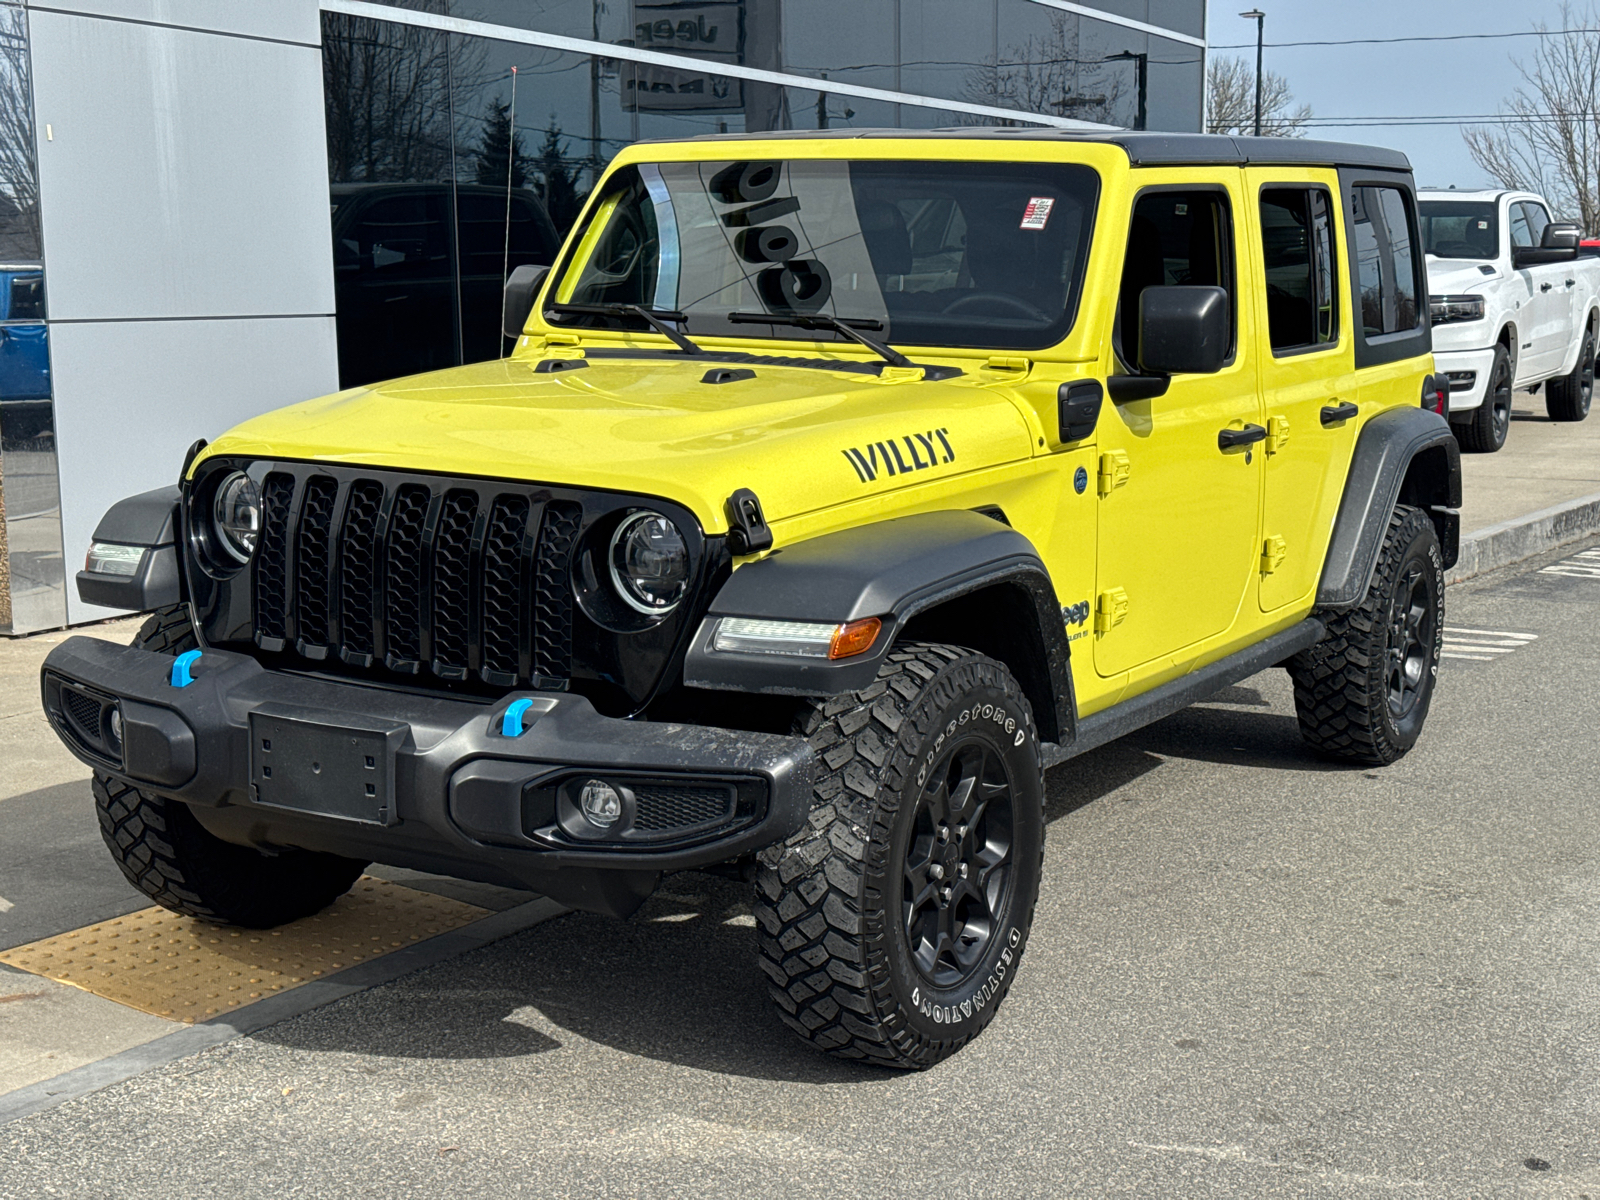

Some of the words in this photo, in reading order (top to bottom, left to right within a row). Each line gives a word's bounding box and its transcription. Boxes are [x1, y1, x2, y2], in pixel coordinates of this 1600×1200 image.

[840, 427, 955, 483] WILLYS
[1061, 600, 1090, 628] eep
[920, 927, 1021, 1024] DESTINATION
